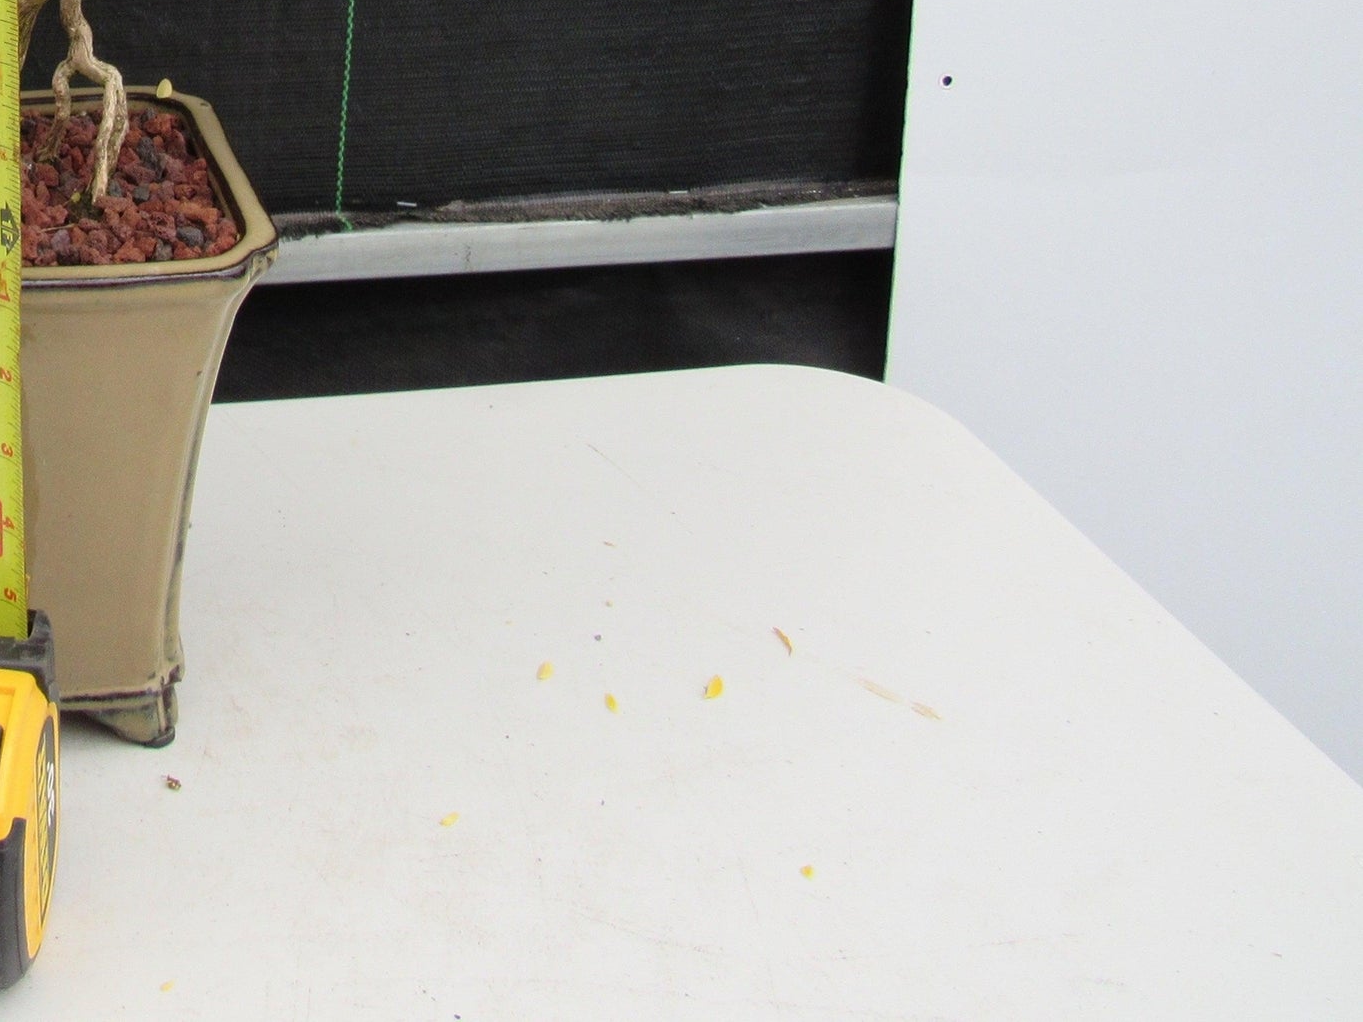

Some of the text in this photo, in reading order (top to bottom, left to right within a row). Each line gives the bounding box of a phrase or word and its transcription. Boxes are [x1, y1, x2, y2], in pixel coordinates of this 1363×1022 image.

[0, 367, 12, 382] 2
[1, 443, 14, 458] 3
[4, 587, 17, 603] 5
